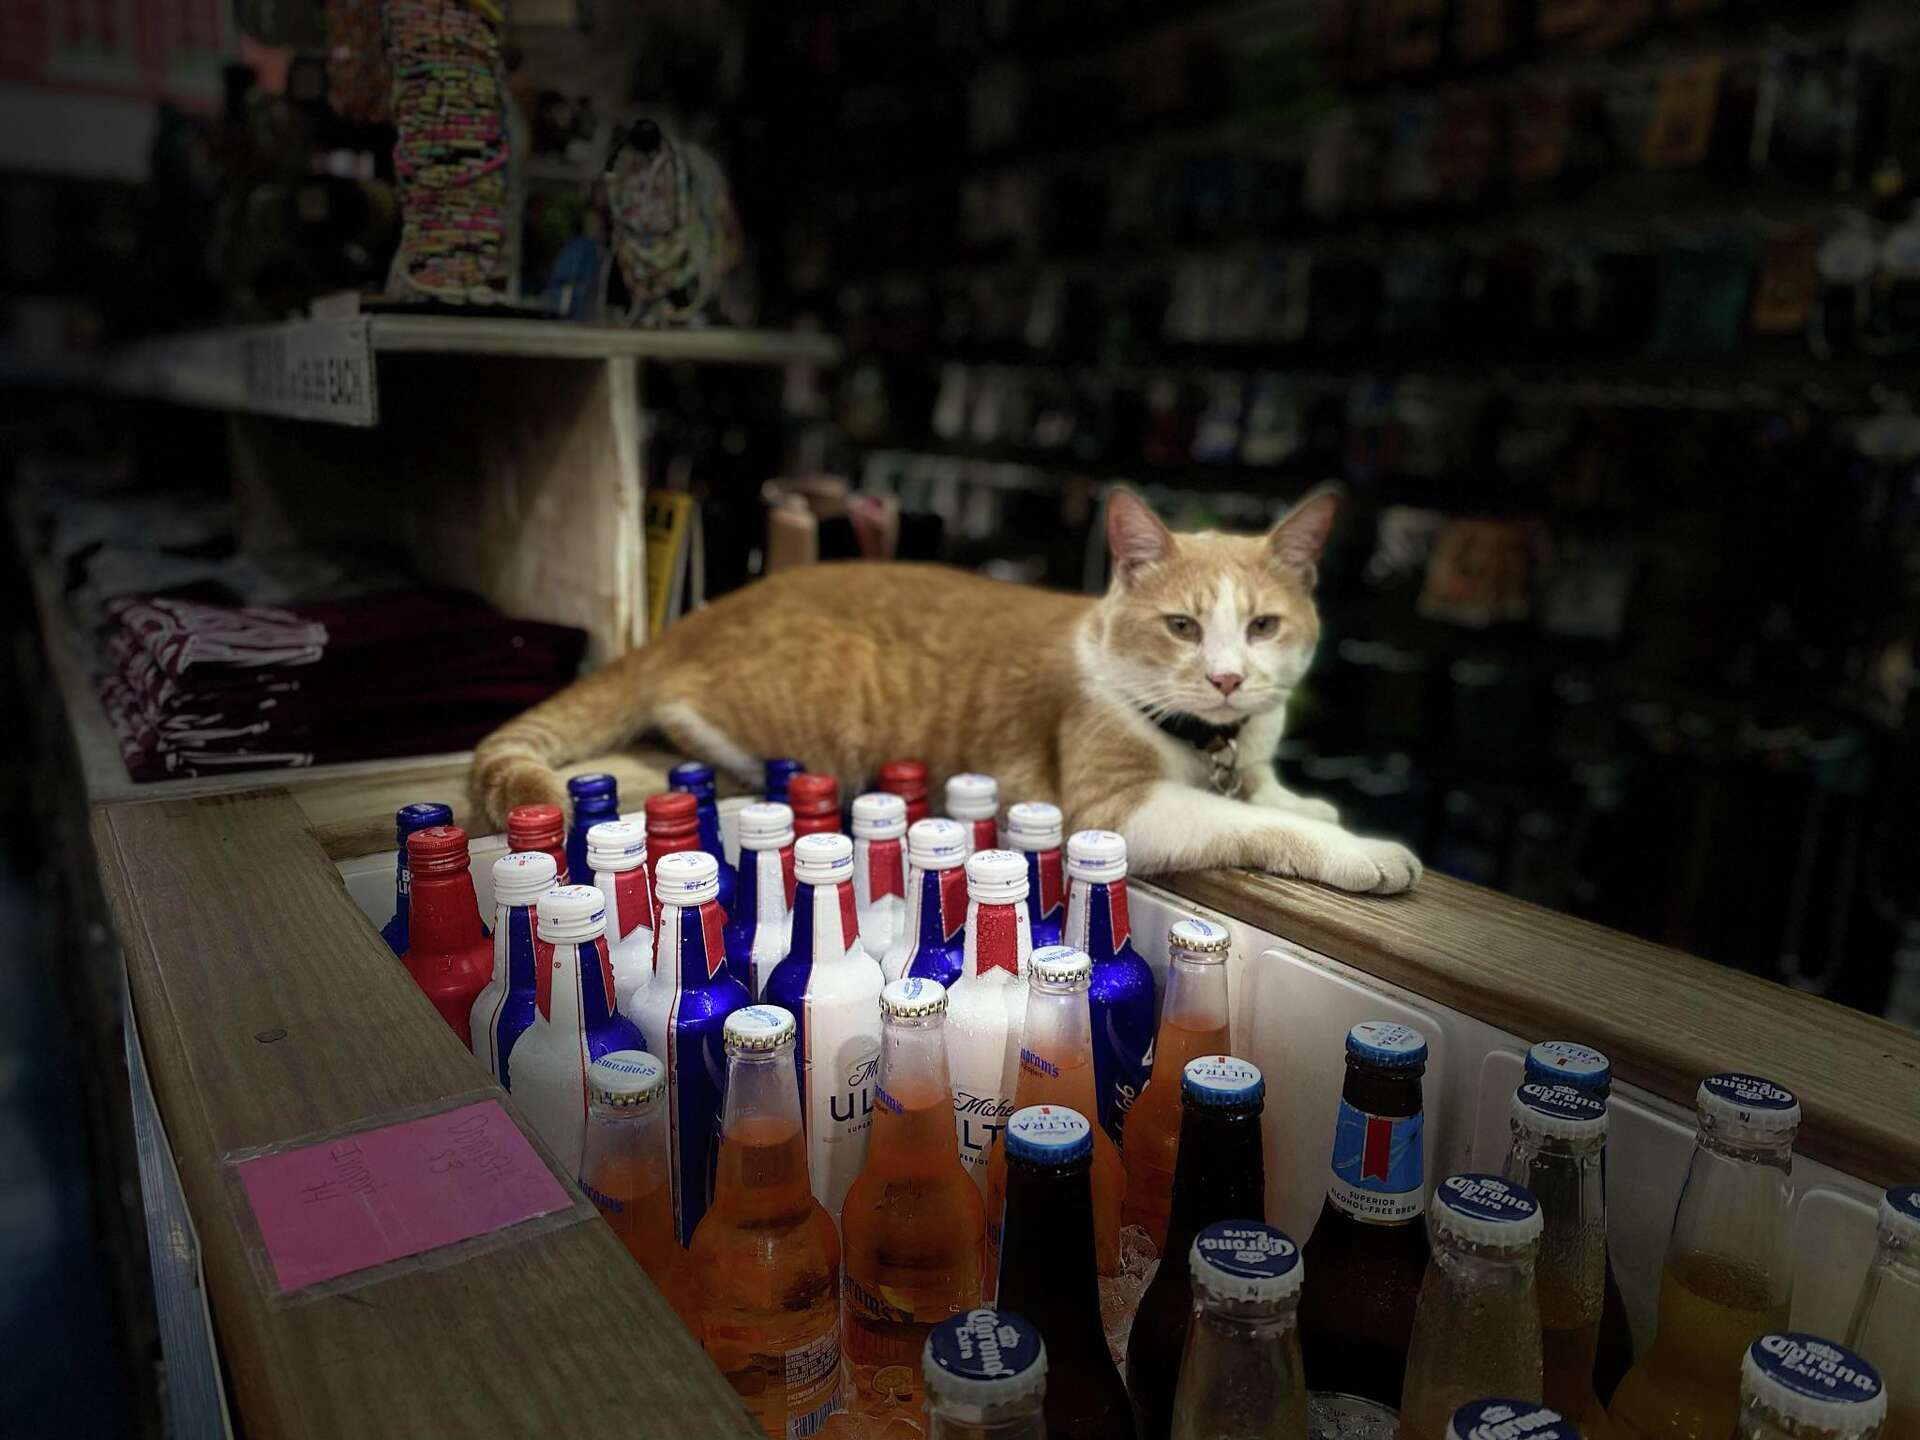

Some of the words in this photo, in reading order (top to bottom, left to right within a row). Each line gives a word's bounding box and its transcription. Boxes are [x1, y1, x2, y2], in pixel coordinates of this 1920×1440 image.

[1542, 1042, 1601, 1063] ULTRA
[1192, 1067, 1253, 1079] ULTRA
[1523, 1083, 1605, 1111] Corona
[1710, 1077, 1793, 1102] Corona
[953, 1092, 1014, 1117] Miche
[1018, 1120, 1083, 1131] ULTRA
[1349, 1191, 1396, 1206] SUPERIOR
[1444, 1176, 1534, 1213] Corona
[1458, 1193, 1503, 1211] Extra
[1199, 1236, 1297, 1256] Corona
[1223, 1229, 1268, 1242] Extra
[966, 1308, 1008, 1378] Corona
[1760, 1334, 1878, 1393] Corona
[1780, 1354, 1838, 1388] Extra
